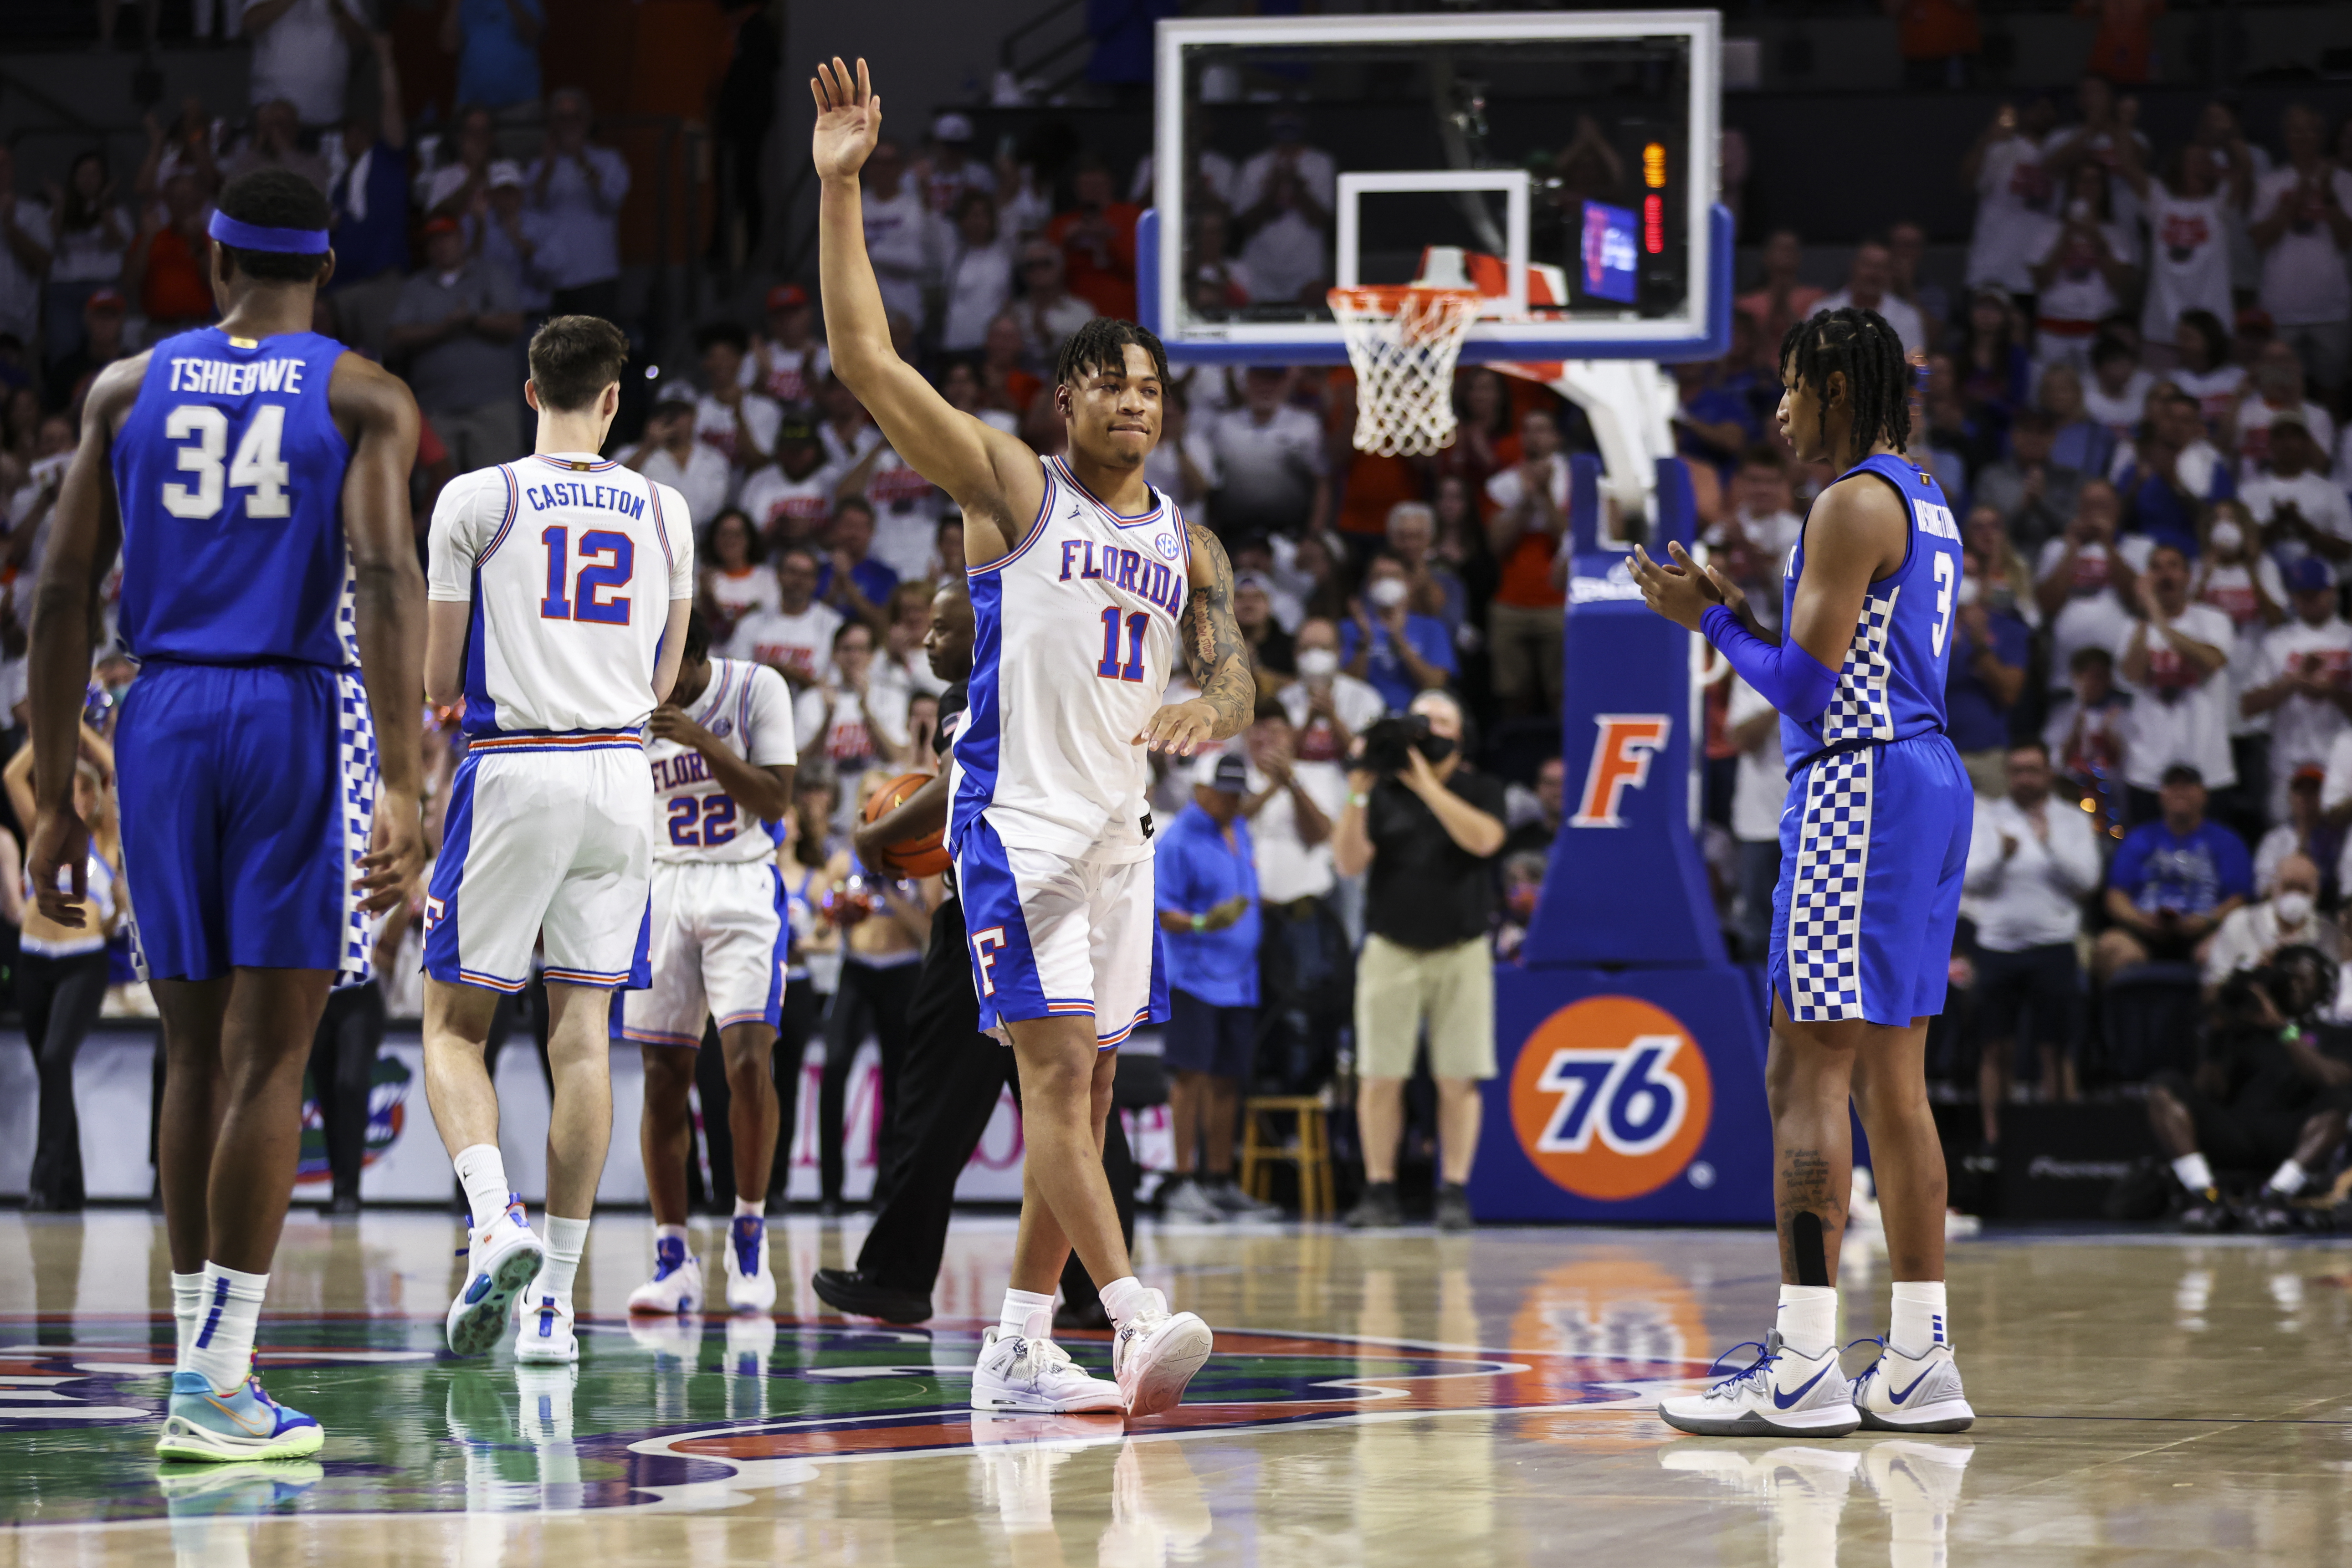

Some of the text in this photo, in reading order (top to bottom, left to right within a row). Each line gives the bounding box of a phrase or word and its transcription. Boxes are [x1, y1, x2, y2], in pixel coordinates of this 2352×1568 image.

[170, 358, 306, 395] TSHIEBWE
[162, 405, 291, 519] 34
[527, 483, 645, 521] CASTLETON
[541, 525, 635, 626] 12
[1059, 539, 1182, 620] FLORIDA
[1157, 534, 1178, 559] SEC
[1932, 551, 1954, 658] 3
[1097, 606, 1151, 683] 11
[1568, 713, 1674, 828] F
[668, 794, 737, 848] 22
[423, 892, 446, 951] F
[971, 925, 1006, 998] F
[1536, 1034, 1688, 1157] 76
